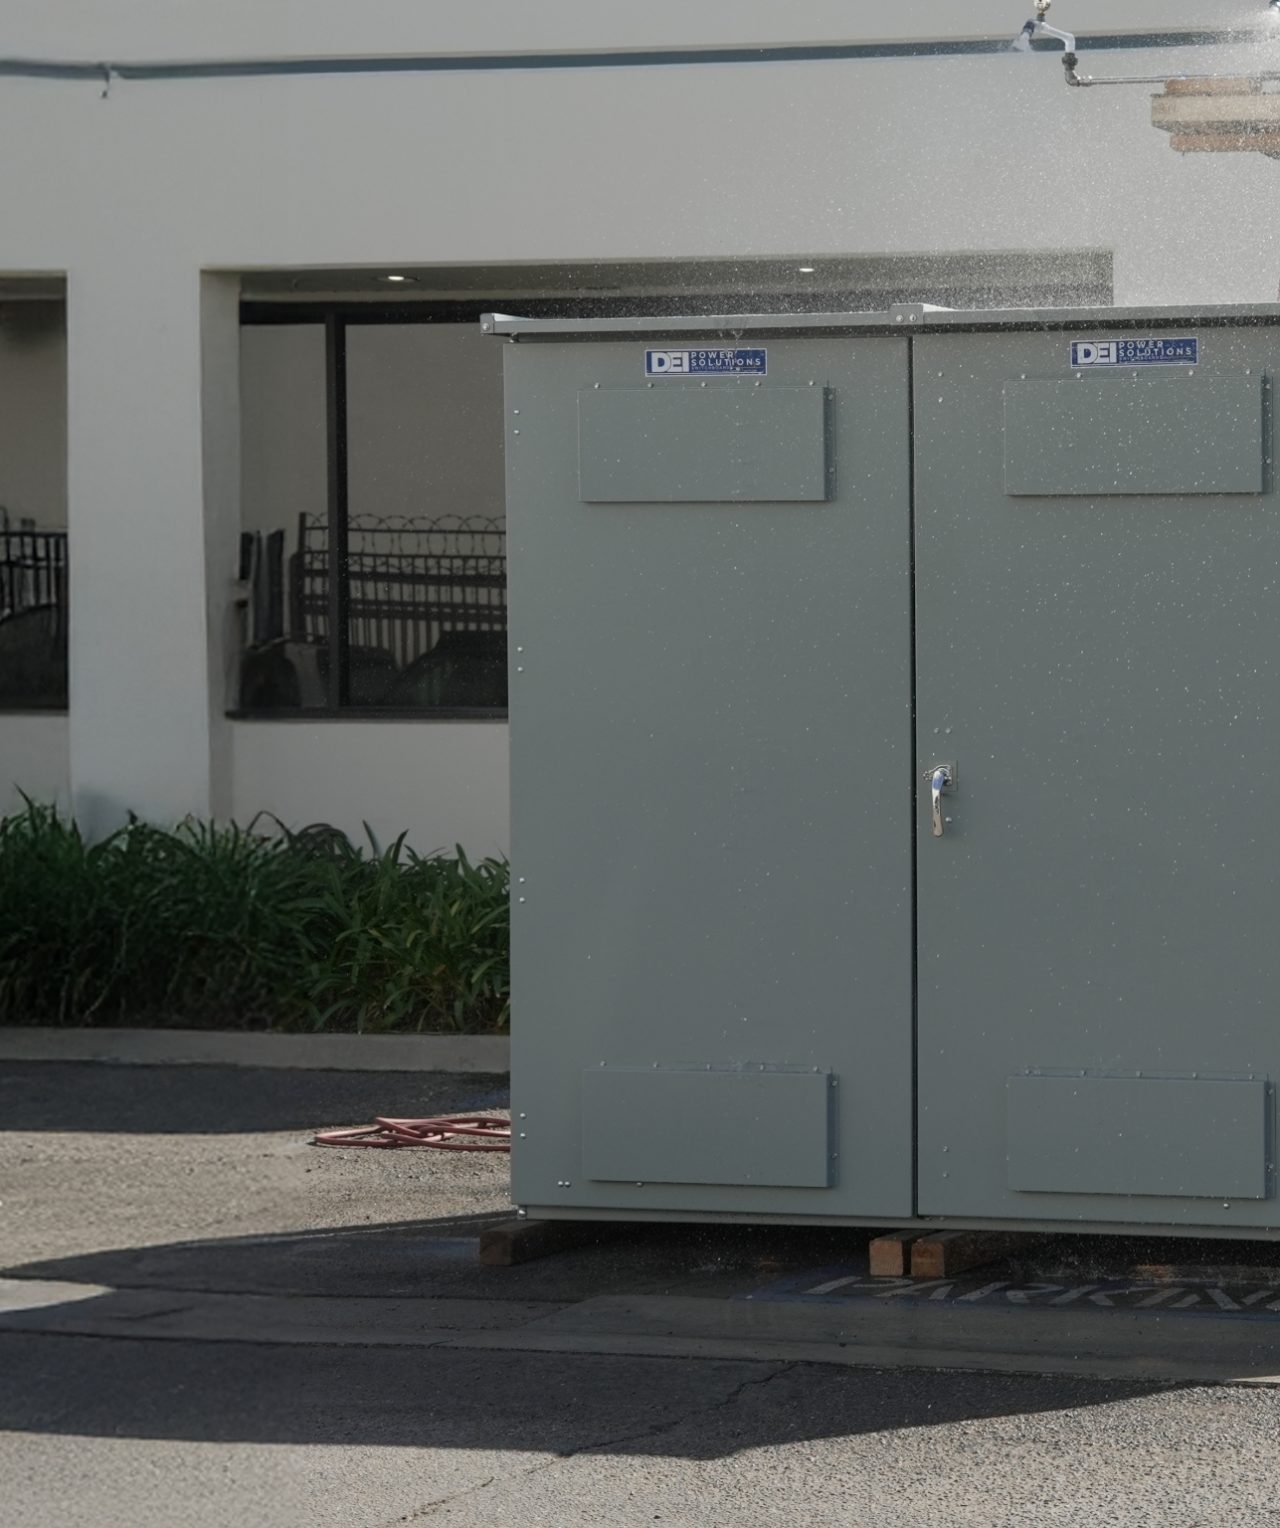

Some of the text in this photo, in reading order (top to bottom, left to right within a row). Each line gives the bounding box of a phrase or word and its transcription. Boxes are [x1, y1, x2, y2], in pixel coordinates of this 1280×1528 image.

[1118, 341, 1164, 350] POWER
[691, 351, 734, 359] POWER
[1076, 342, 1117, 364] DEI
[1118, 347, 1192, 357] SOLUTIONS
[651, 351, 690, 373] DEI
[691, 358, 762, 366] SOLUTIONS
